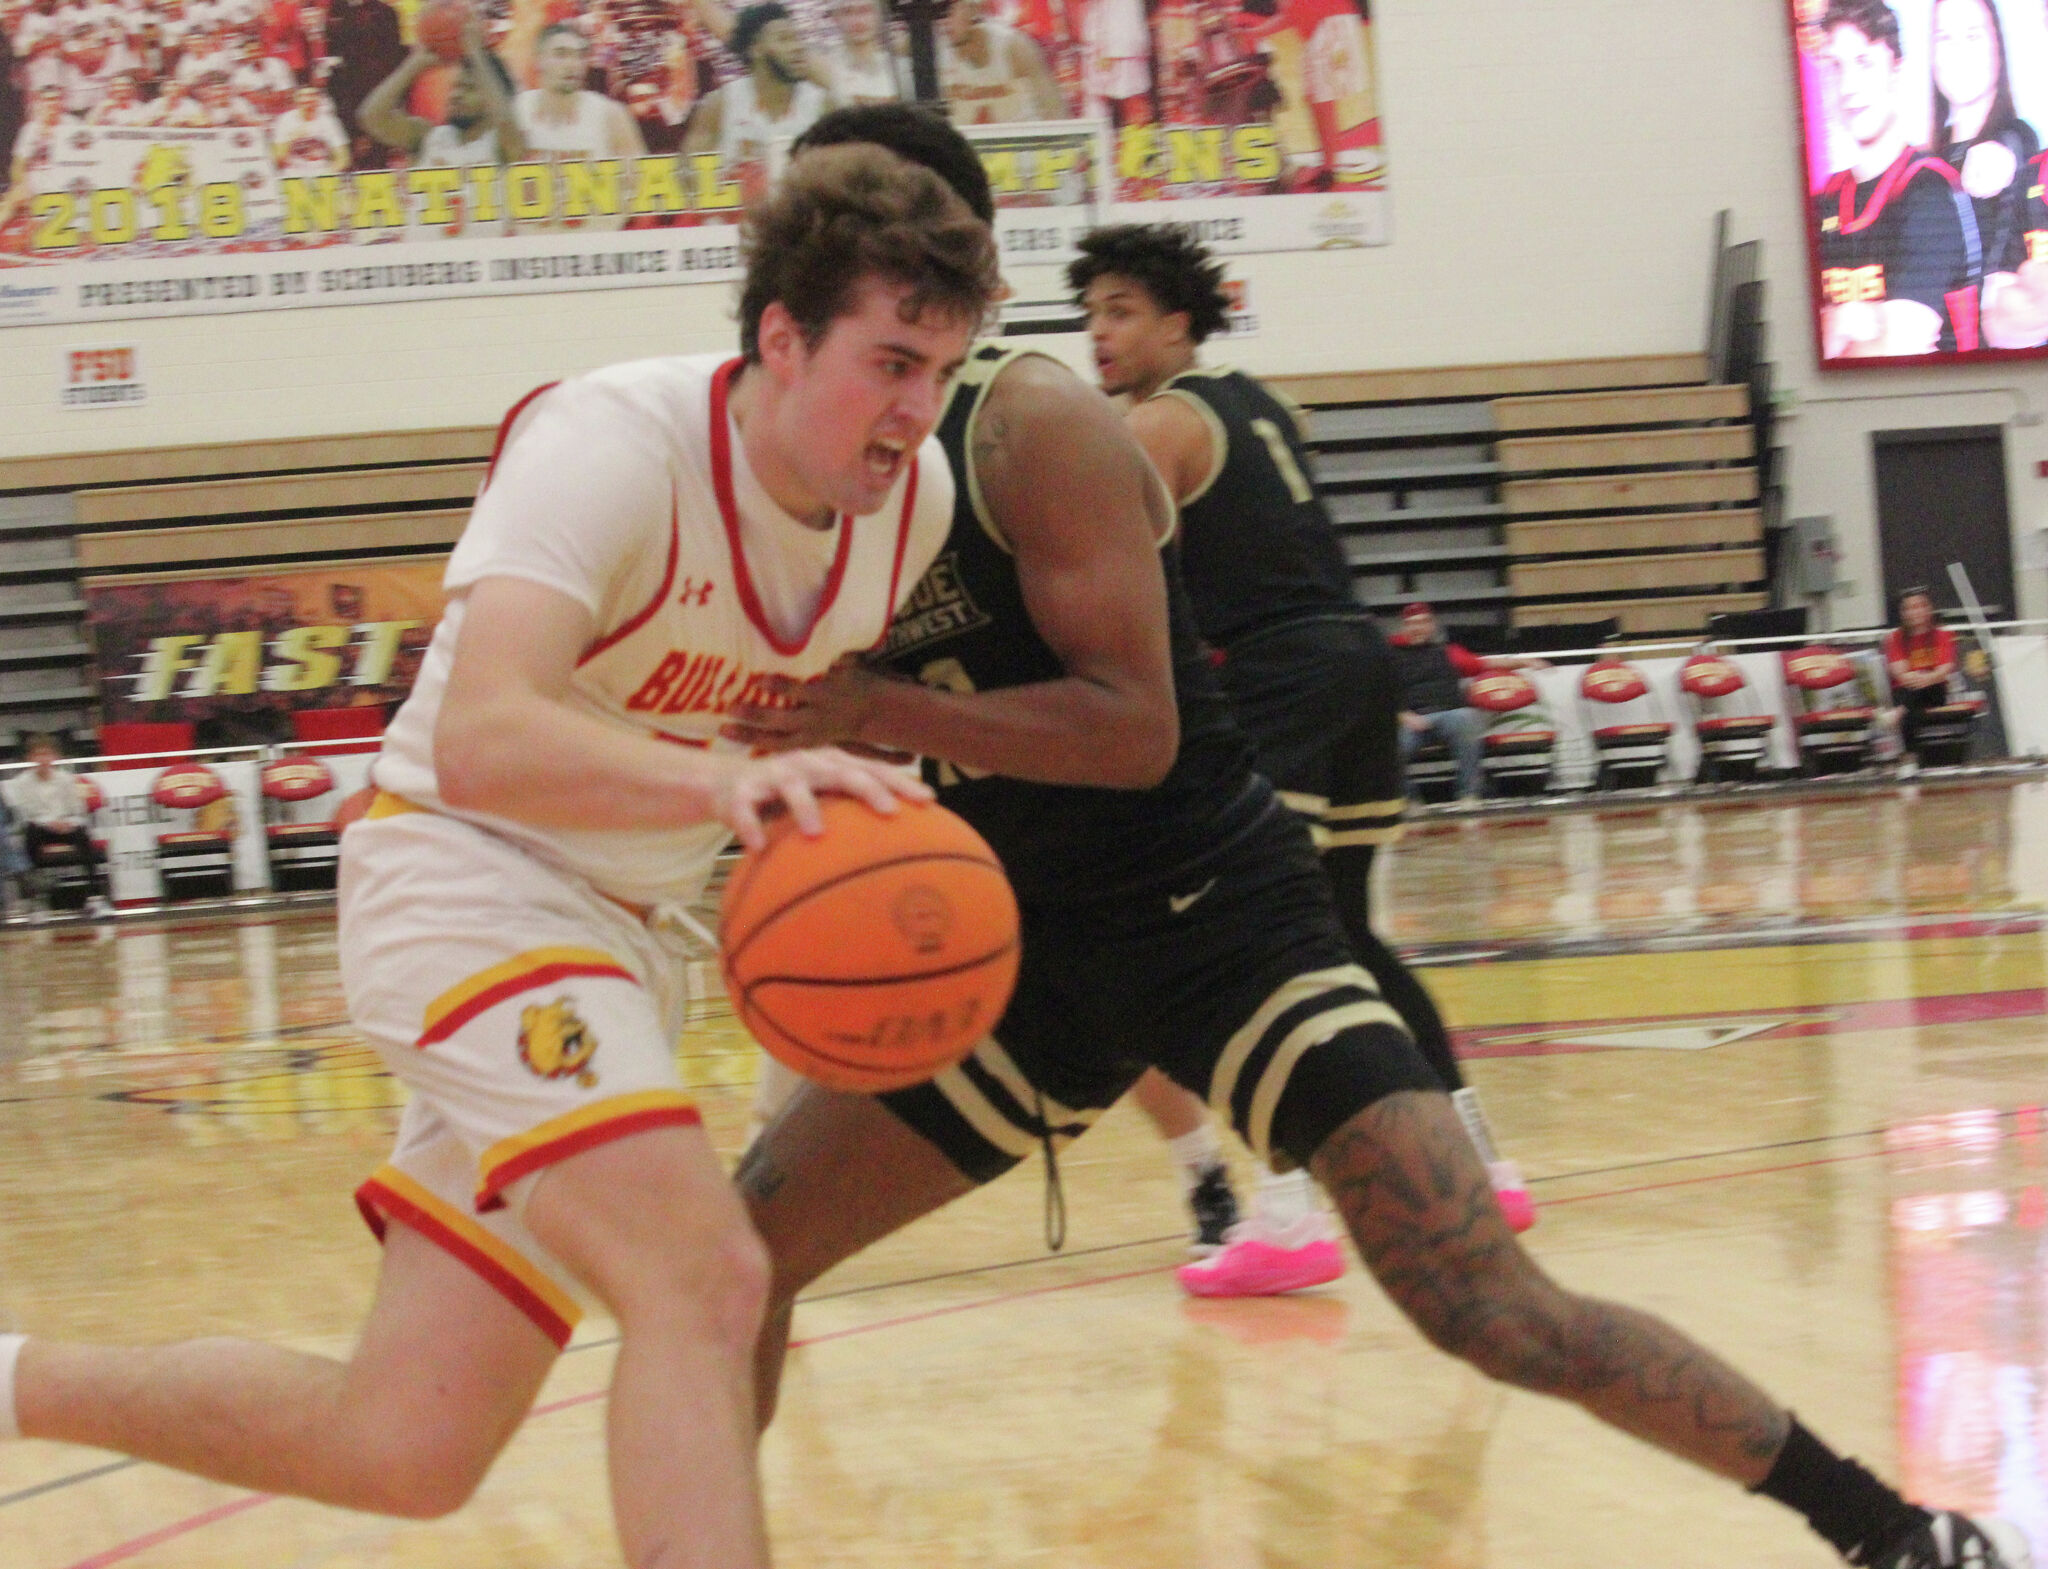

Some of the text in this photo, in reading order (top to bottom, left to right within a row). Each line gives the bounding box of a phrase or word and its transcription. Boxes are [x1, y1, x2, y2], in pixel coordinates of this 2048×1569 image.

[31, 182, 246, 249] 2018
[281, 153, 743, 235] NATIONAL
[80, 274, 258, 307] PRESENTED
[271, 271, 309, 296] BY
[490, 250, 670, 281] INSURANCE
[70, 348, 134, 383] FSU
[1252, 418, 1313, 503] 1
[127, 619, 425, 701] FAST
